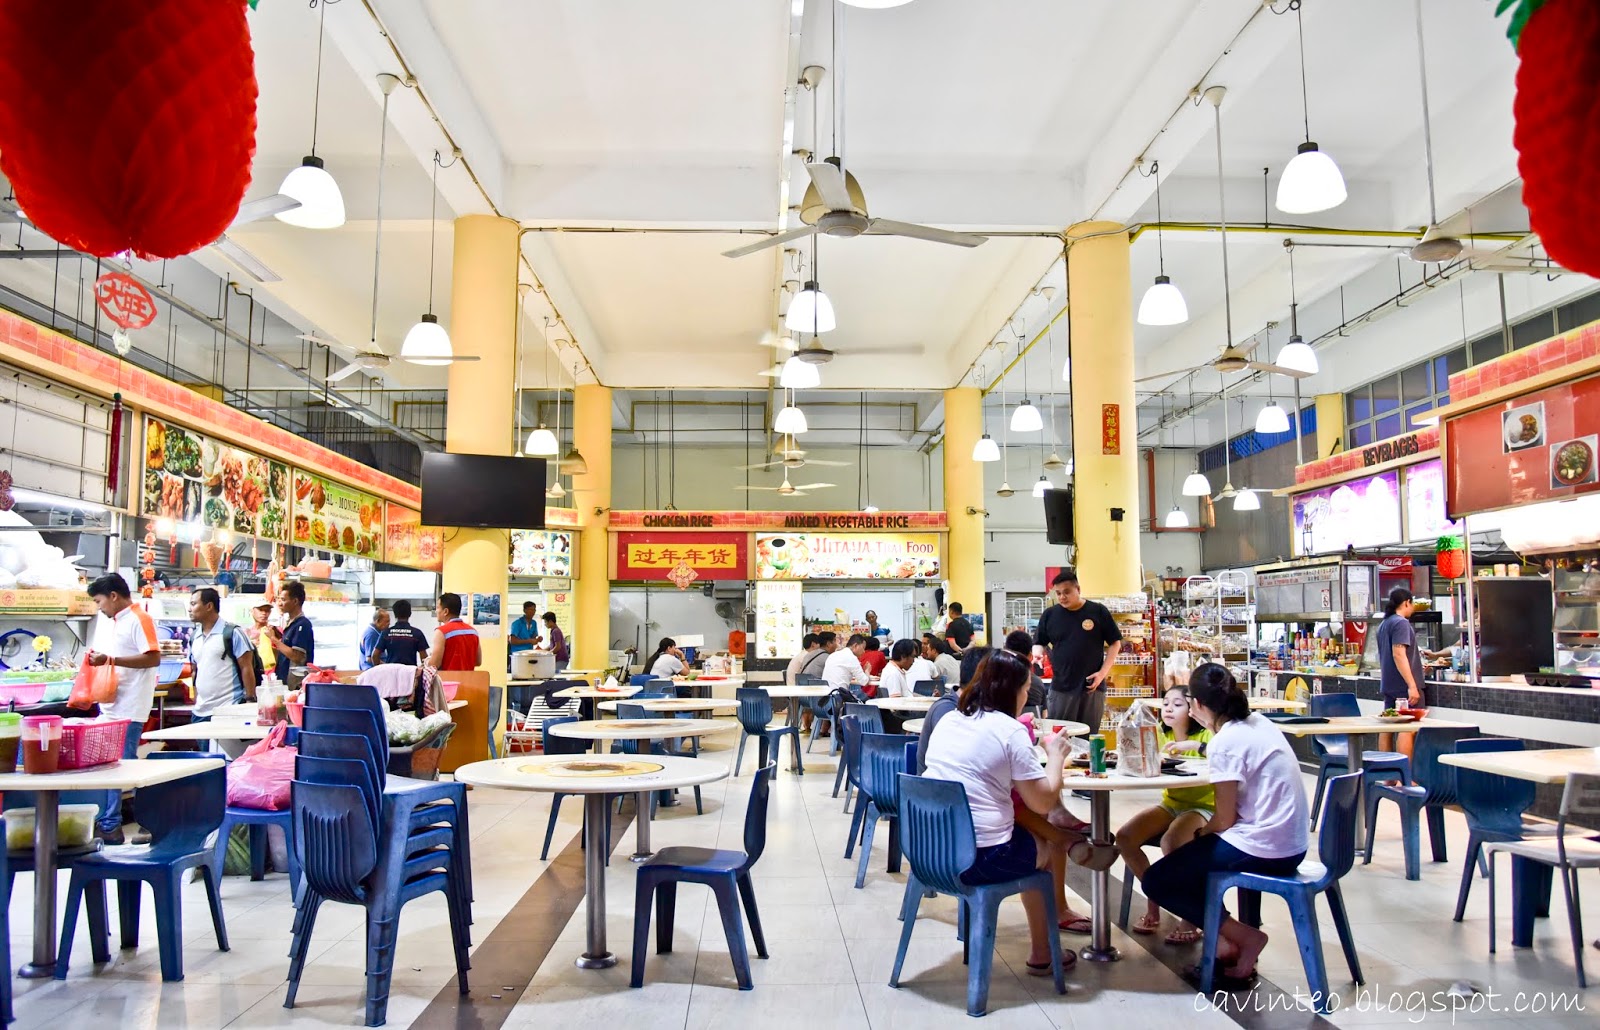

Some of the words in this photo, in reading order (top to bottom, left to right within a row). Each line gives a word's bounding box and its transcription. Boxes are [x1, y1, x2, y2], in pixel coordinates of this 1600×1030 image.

[1362, 434, 1419, 468] BEVERAGES
[643, 515, 689, 527] CHICKEN
[690, 515, 713, 527] RICE
[784, 515, 820, 528] MIXED
[823, 515, 883, 528] VEGETABLE
[886, 515, 909, 528] RICE
[633, 548, 731, 565] 过年年货
